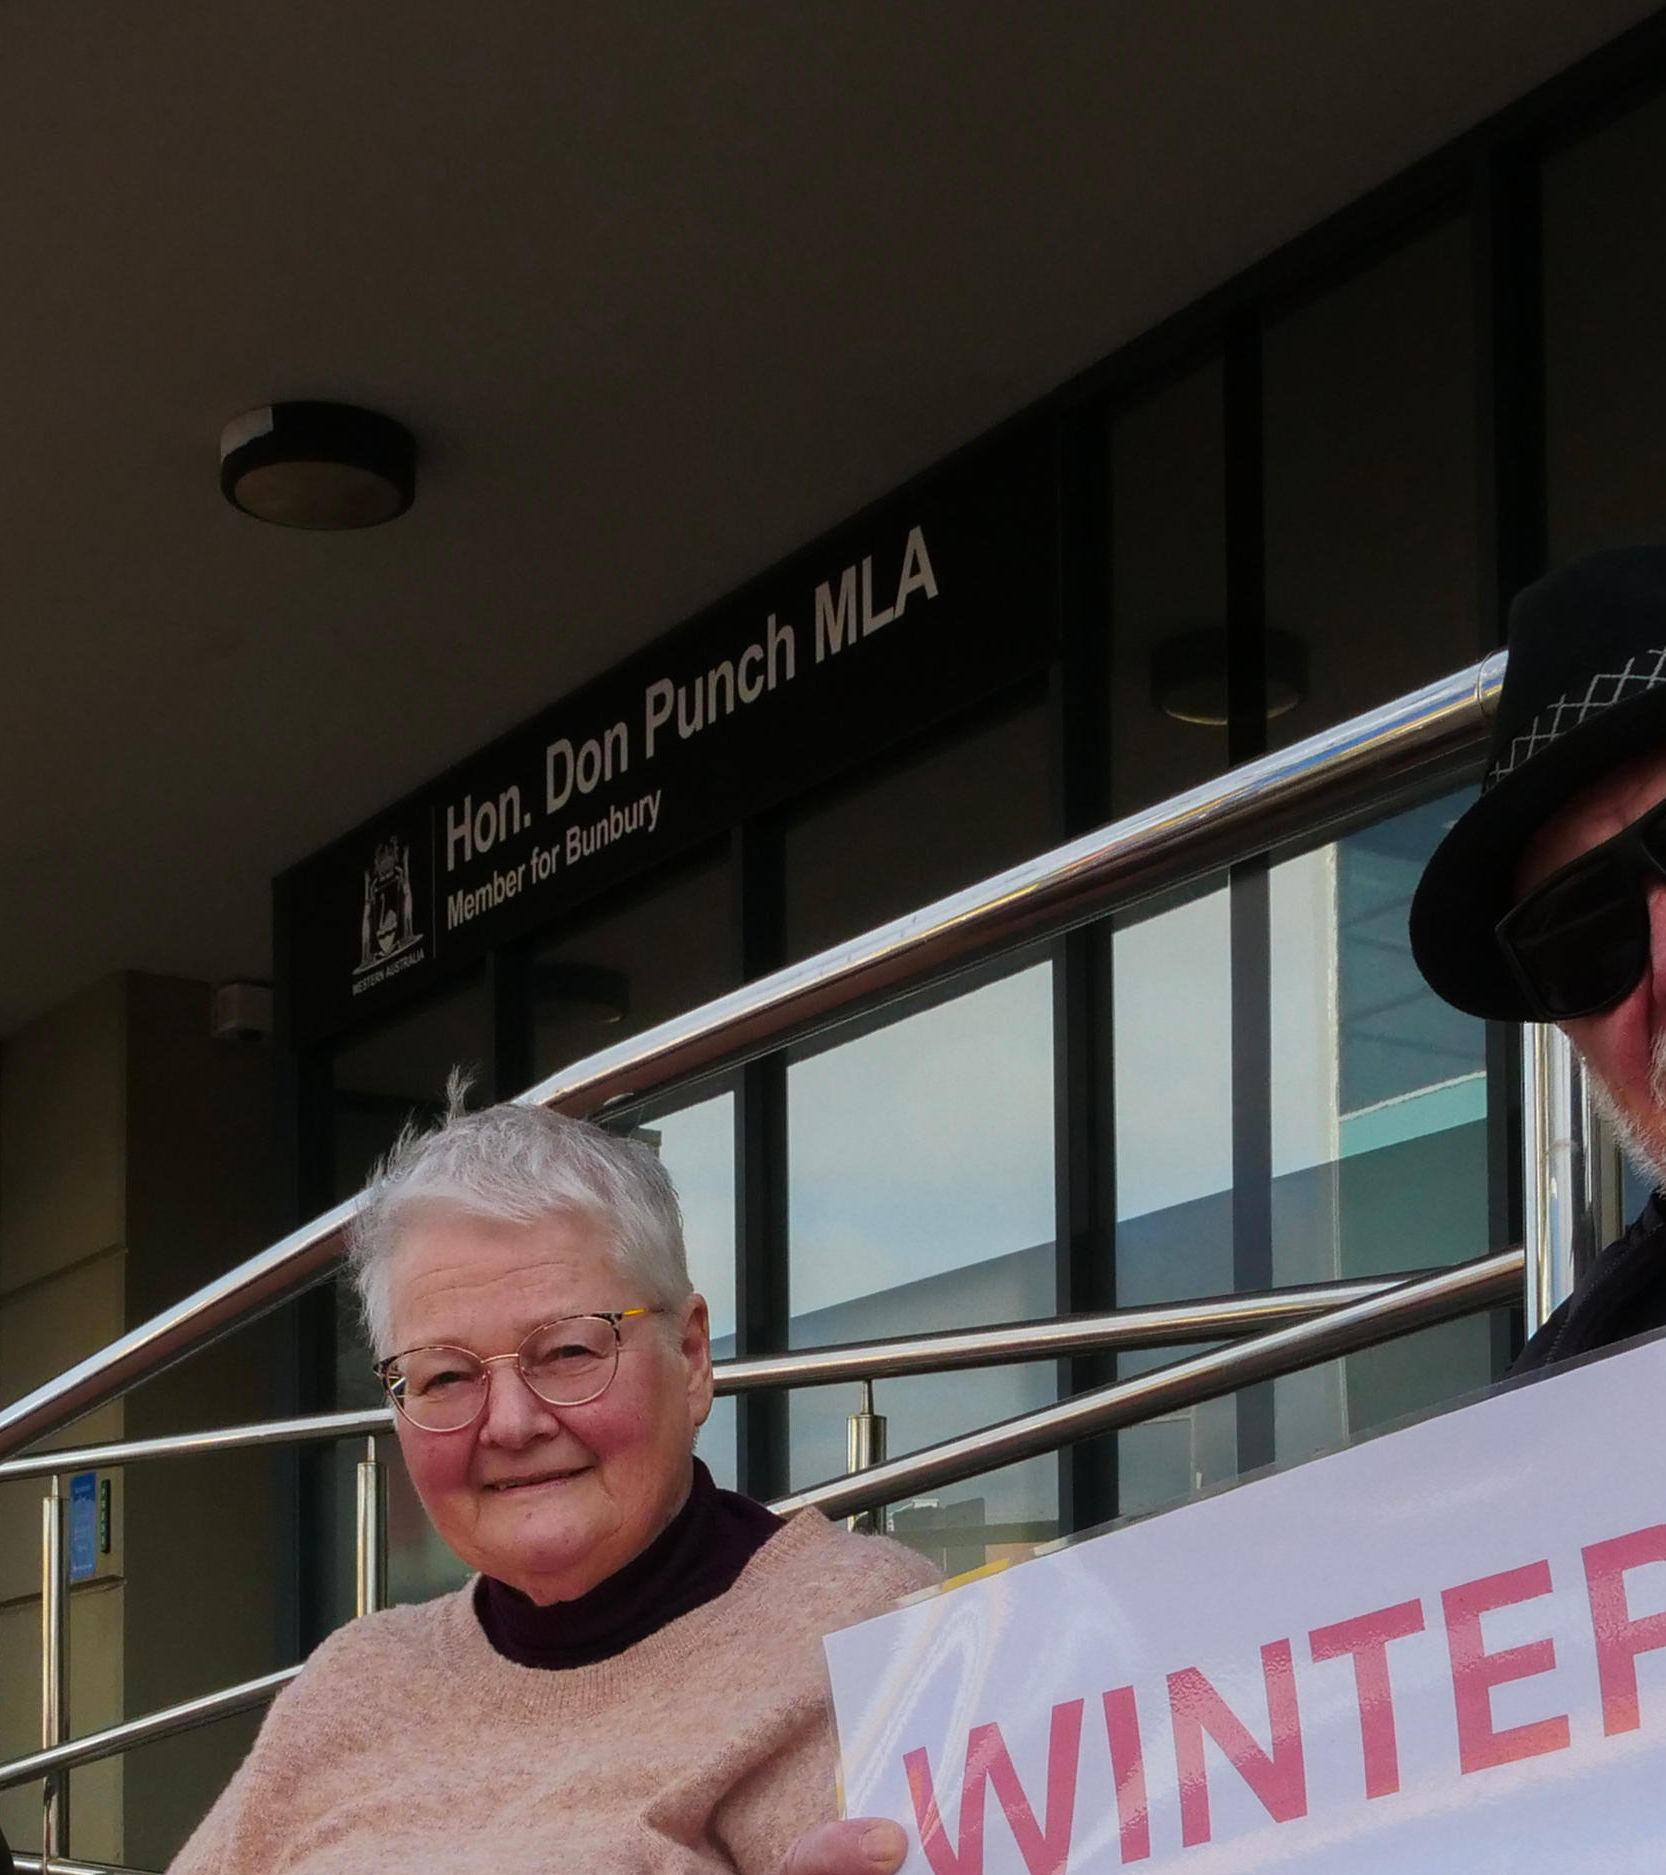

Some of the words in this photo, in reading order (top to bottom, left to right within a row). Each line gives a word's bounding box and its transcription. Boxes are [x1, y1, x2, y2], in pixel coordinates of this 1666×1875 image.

[447, 785, 532, 871] Hon.
[546, 720, 627, 815] Don
[645, 613, 795, 759] Punch
[815, 525, 938, 664] MLA
[448, 861, 525, 930] Member
[531, 840, 560, 885] for
[566, 790, 661, 865] Bunbury
[352, 970, 385, 996] WESTERN
[386, 948, 425, 978] AUSTRALIA
